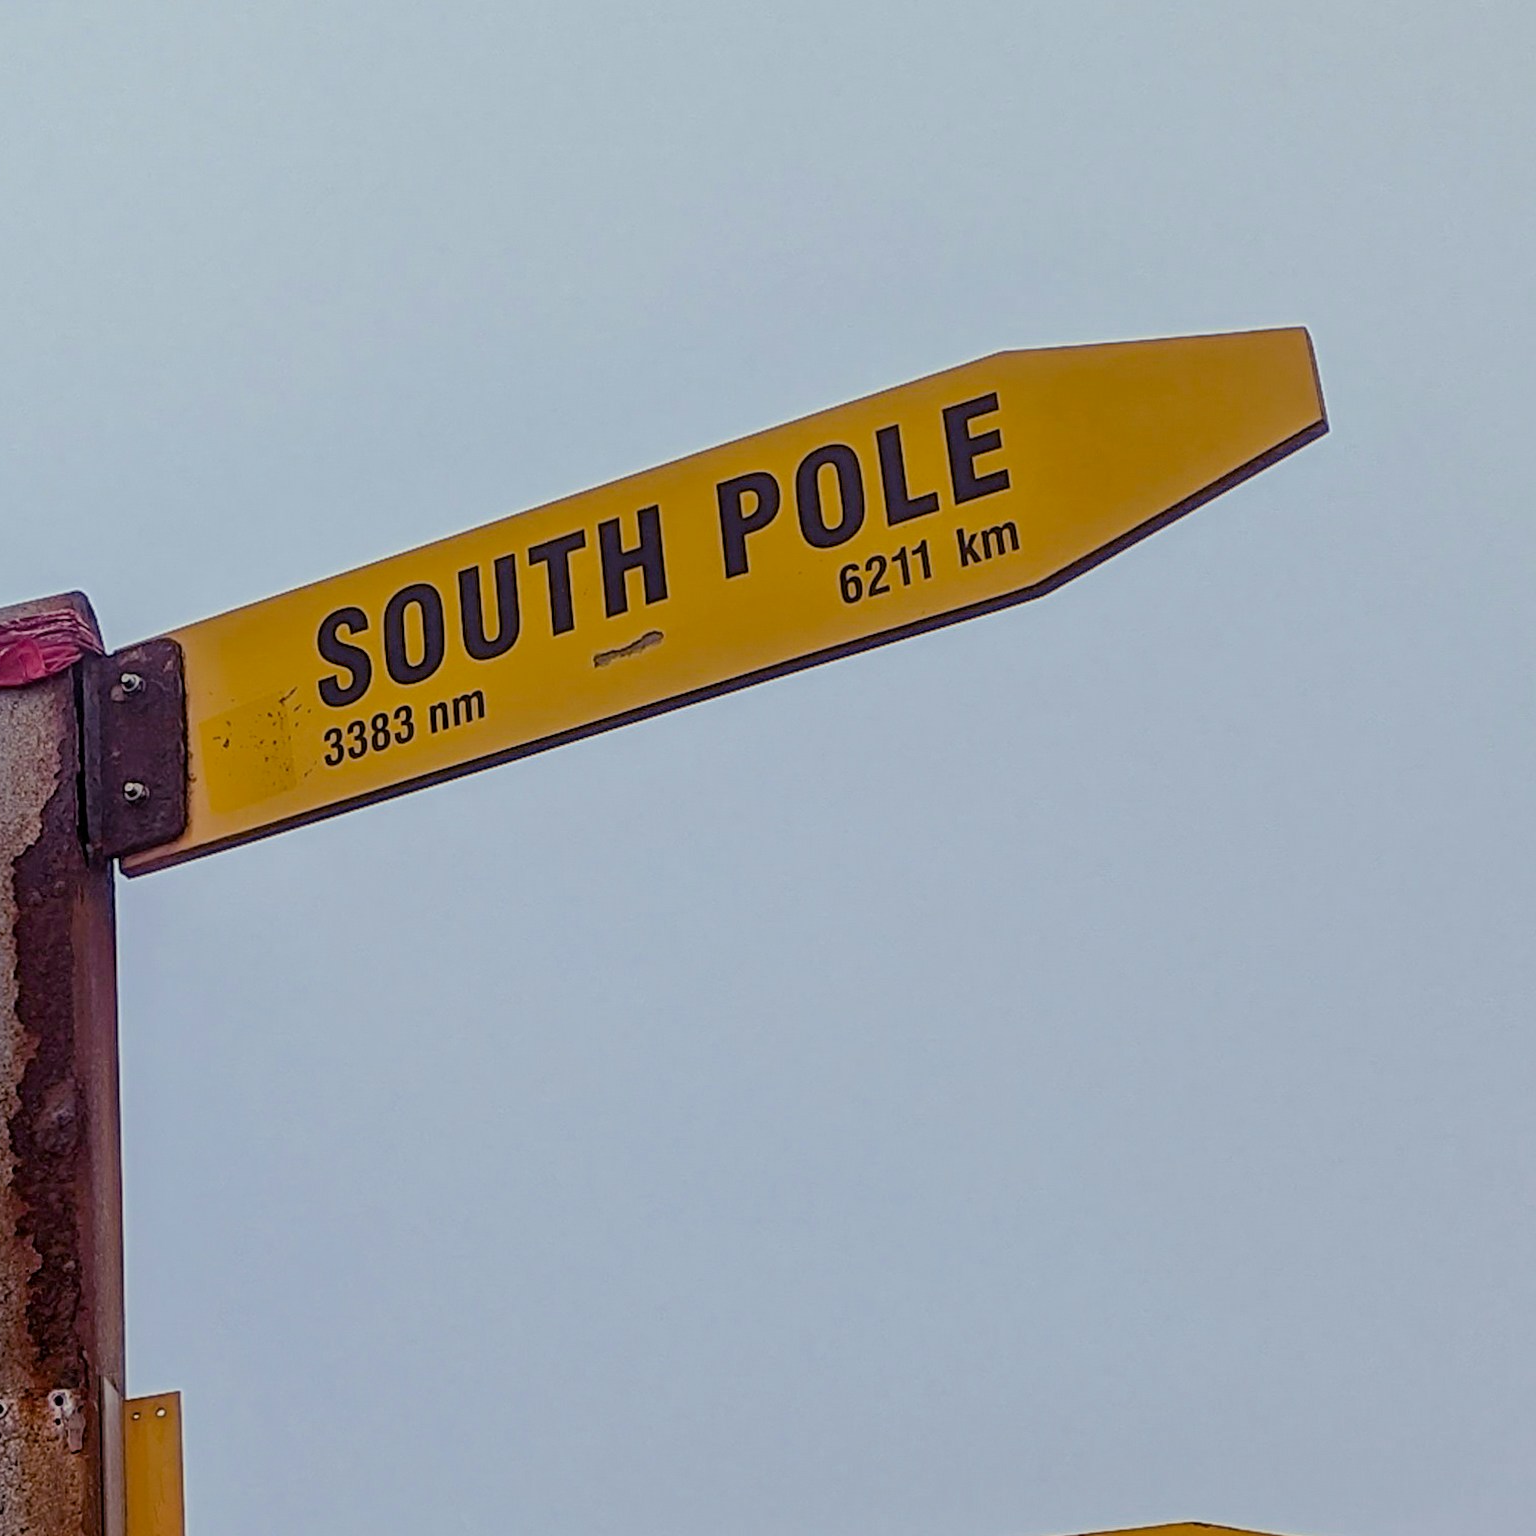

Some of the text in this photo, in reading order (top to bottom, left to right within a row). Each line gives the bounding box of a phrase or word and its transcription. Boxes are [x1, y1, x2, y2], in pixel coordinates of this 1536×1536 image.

[316, 392, 1010, 707] SOUTH POLE
[840, 519, 1020, 604] 6211 km
[322, 690, 485, 767] 3383 nm
